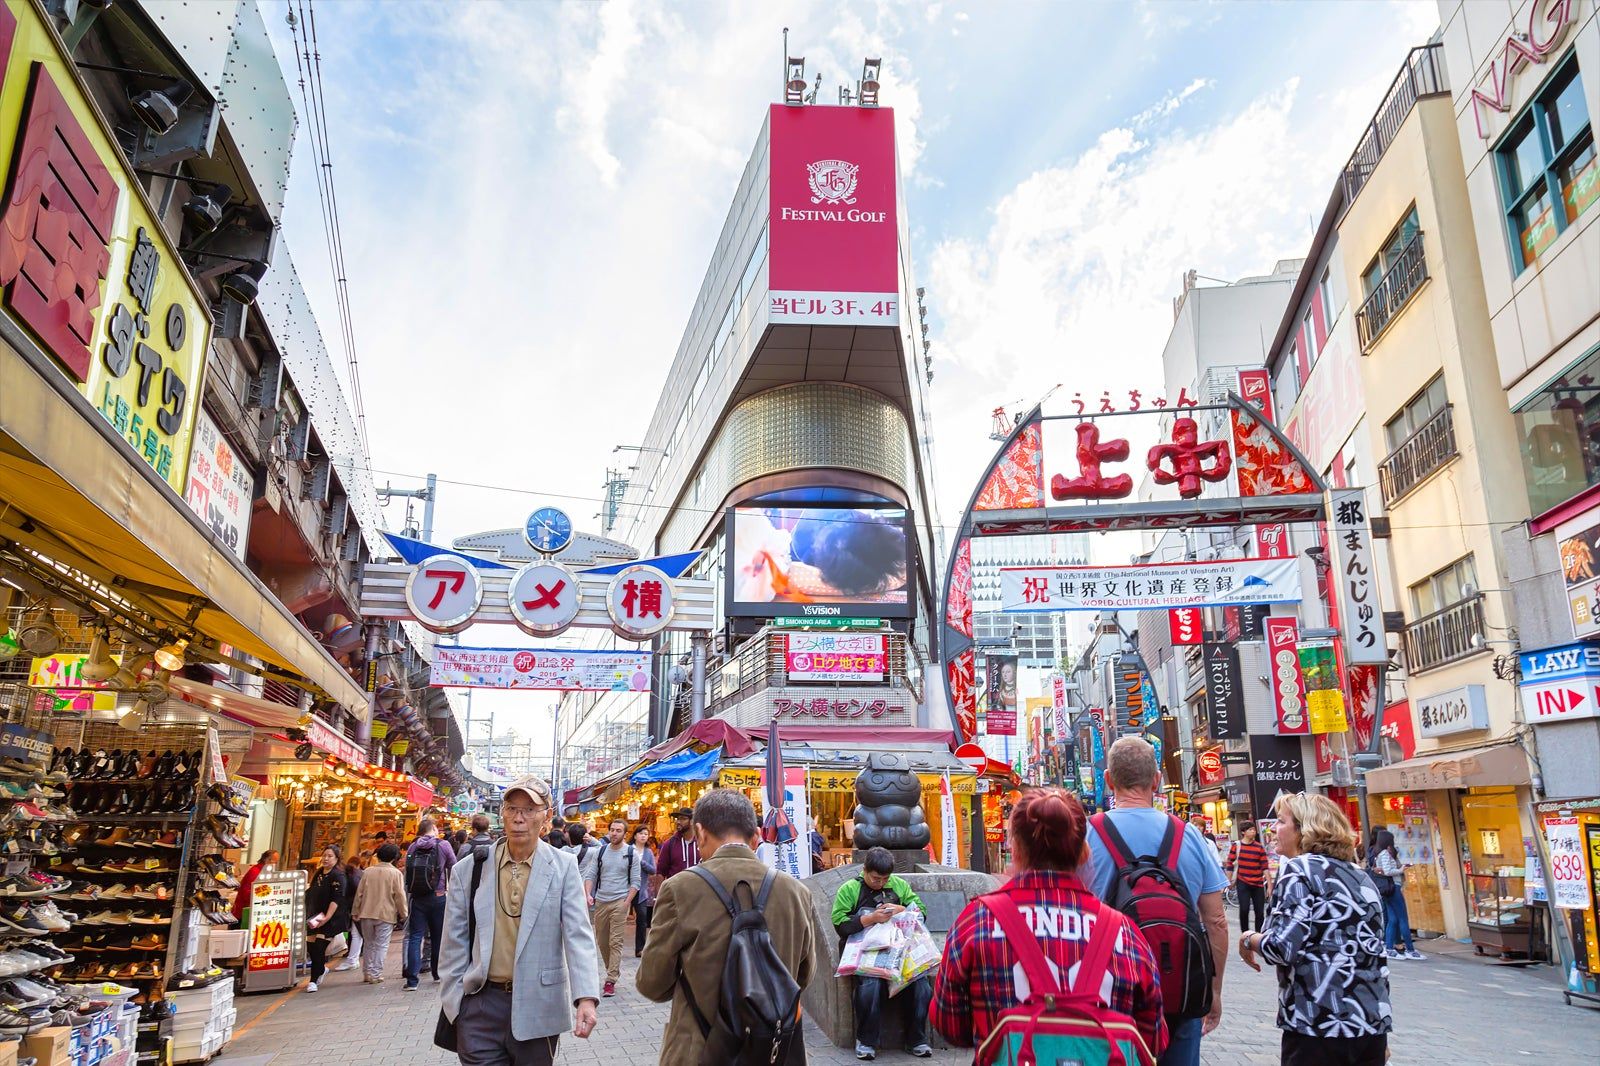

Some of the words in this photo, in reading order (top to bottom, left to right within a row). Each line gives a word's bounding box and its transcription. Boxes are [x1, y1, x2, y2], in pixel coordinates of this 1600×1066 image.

[781, 207, 845, 221] FESTIVAL
[847, 209, 886, 223] GOLF
[1051, 418, 1232, 500] 上中
[1152, 568, 1179, 576] Museum
[1336, 500, 1376, 648] 都まんじゅう
[425, 569, 662, 619] アメ横
[1021, 576, 1050, 604] 祝
[1059, 576, 1234, 598] 世界文化遺産登録
[1082, 599, 1114, 607] WORLD
[1117, 597, 1160, 606] CULTURAL
[1163, 595, 1207, 605] HERITAGE
[790, 635, 877, 652] アメ横女学園
[516, 654, 533, 670] 祝
[813, 656, 876, 670] ロケ地です
[772, 698, 905, 719] アメ横センター
[1212, 663, 1229, 736] ROOMPIA
[1536, 688, 1567, 716] IN
[1421, 697, 1468, 730] 都まんじゅう
[11, 735, 54, 754] SKECHERS
[1255, 759, 1301, 769] カンタン
[1256, 771, 1301, 781] 部屋さがし
[1553, 854, 1582, 881] 839
[252, 922, 283, 950] 190
